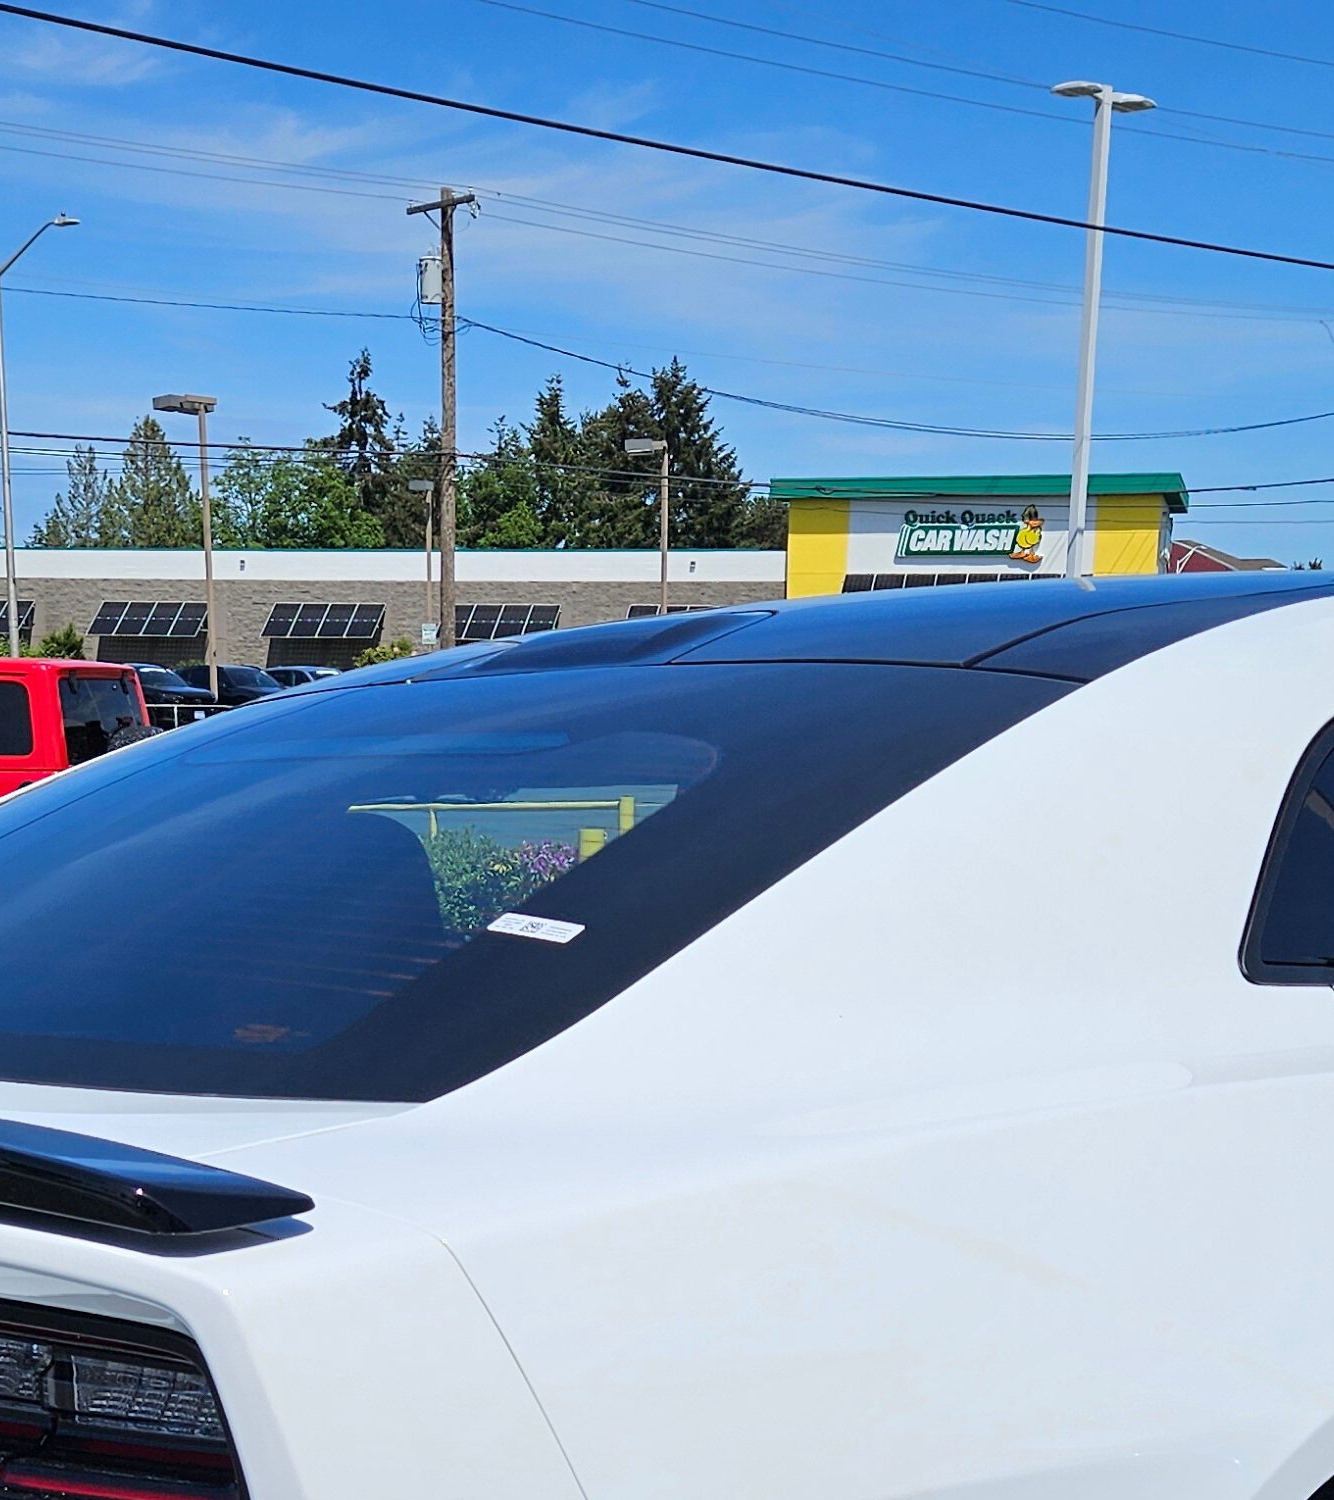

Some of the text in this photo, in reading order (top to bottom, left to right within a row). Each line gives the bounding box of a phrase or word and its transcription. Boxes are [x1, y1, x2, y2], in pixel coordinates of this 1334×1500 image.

[904, 510, 1017, 526] Quick Quack
[909, 528, 1016, 551] CAR WASH
